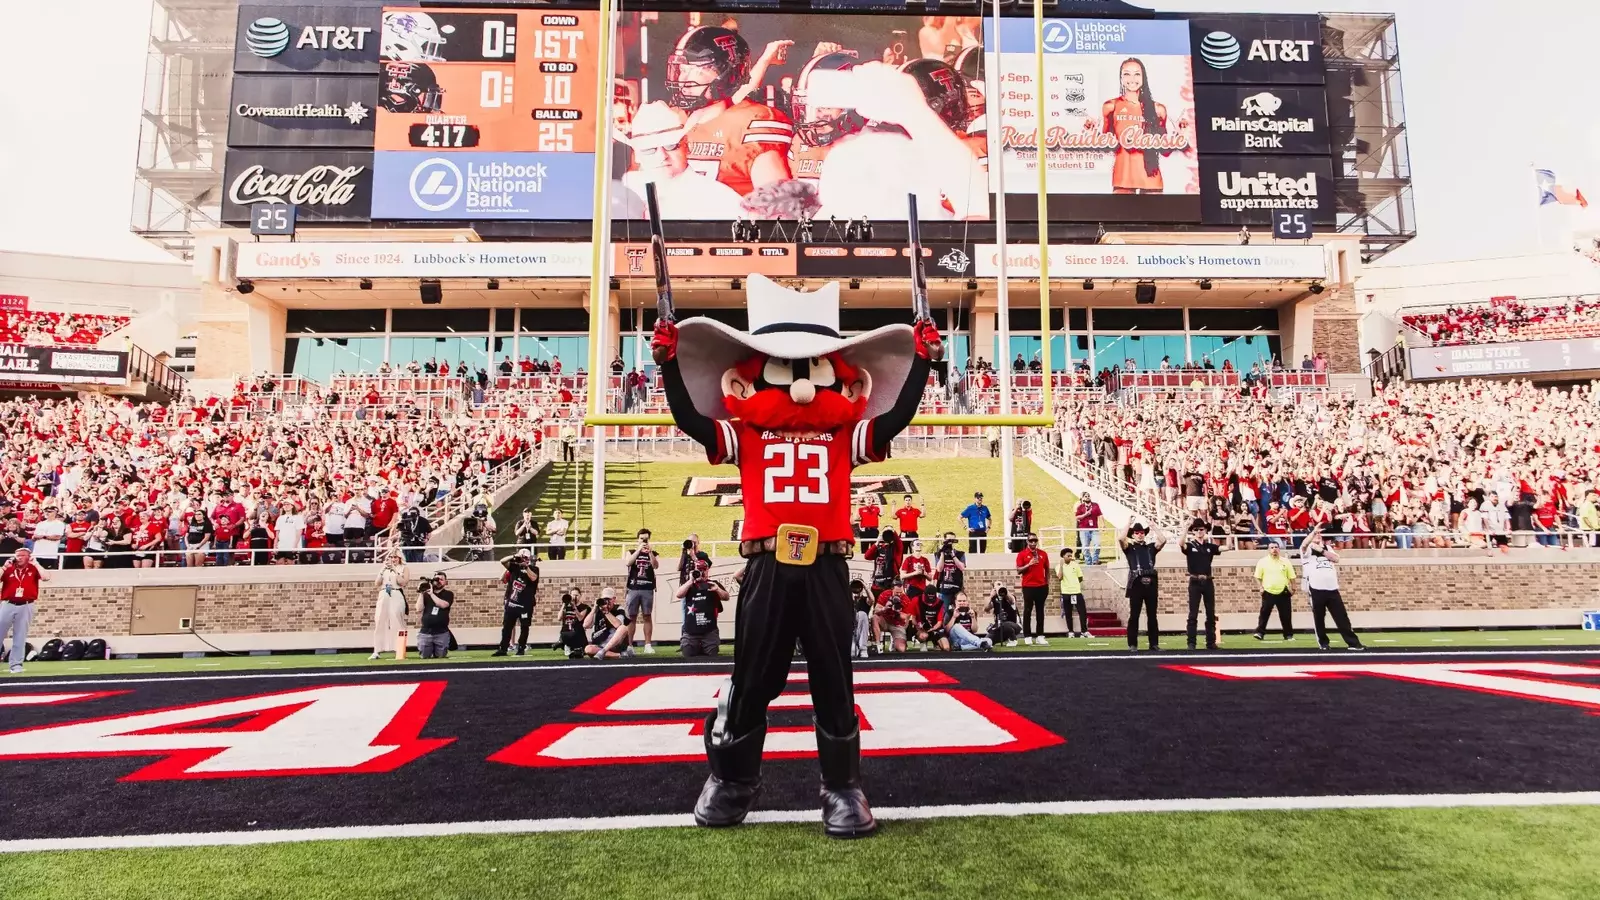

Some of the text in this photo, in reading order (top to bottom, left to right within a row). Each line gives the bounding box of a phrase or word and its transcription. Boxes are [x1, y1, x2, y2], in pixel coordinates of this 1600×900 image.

[543, 15, 576, 26] DOWN
[1074, 21, 1127, 33] Lubbock
[295, 25, 372, 51] AT&T
[481, 20, 505, 58] 0
[533, 29, 584, 59] 1ST
[1074, 31, 1125, 42] National
[1075, 40, 1107, 51] Bank
[1247, 39, 1315, 62] AT&T
[542, 62, 574, 72] TO GO
[1007, 73, 1033, 84] Sep.
[479, 70, 503, 108] 0
[543, 75, 572, 105] 10
[1008, 91, 1034, 102] Sep.
[235, 103, 343, 118] CovenantHealth
[535, 110, 578, 120] BALL ON
[1009, 108, 1035, 118] Sep.
[1211, 117, 1315, 134] PlainsCapital
[420, 125, 466, 148] 4:17
[538, 122, 574, 152] 25
[1001, 124, 1188, 149] Red Raider Classic
[1244, 133, 1283, 148] Bank
[1059, 152, 1074, 161] get
[1075, 151, 1084, 160] in
[1085, 151, 1104, 160] free
[466, 161, 548, 178] Lubbock
[1084, 161, 1095, 169] ID
[228, 164, 365, 206] Coca-Cola
[466, 177, 543, 194] National
[1217, 171, 1318, 197] United
[465, 192, 514, 208] Bank
[1219, 197, 1319, 212] supermarkets
[256, 208, 288, 230] 25
[1279, 213, 1307, 234] 25
[255, 251, 321, 269] Gandy's
[335, 252, 371, 265] Since
[373, 252, 404, 265] 1924.
[413, 252, 476, 265] Lubbock's
[480, 252, 547, 265] Hometown
[1064, 254, 1097, 265] Since
[1100, 254, 1129, 265] 1924.
[1137, 254, 1195, 266] Lubbock's
[1198, 255, 1261, 266] Hometown
[1484, 346, 1522, 359] STATE
[1494, 358, 1531, 370] STATE
[763, 443, 830, 504] 23
